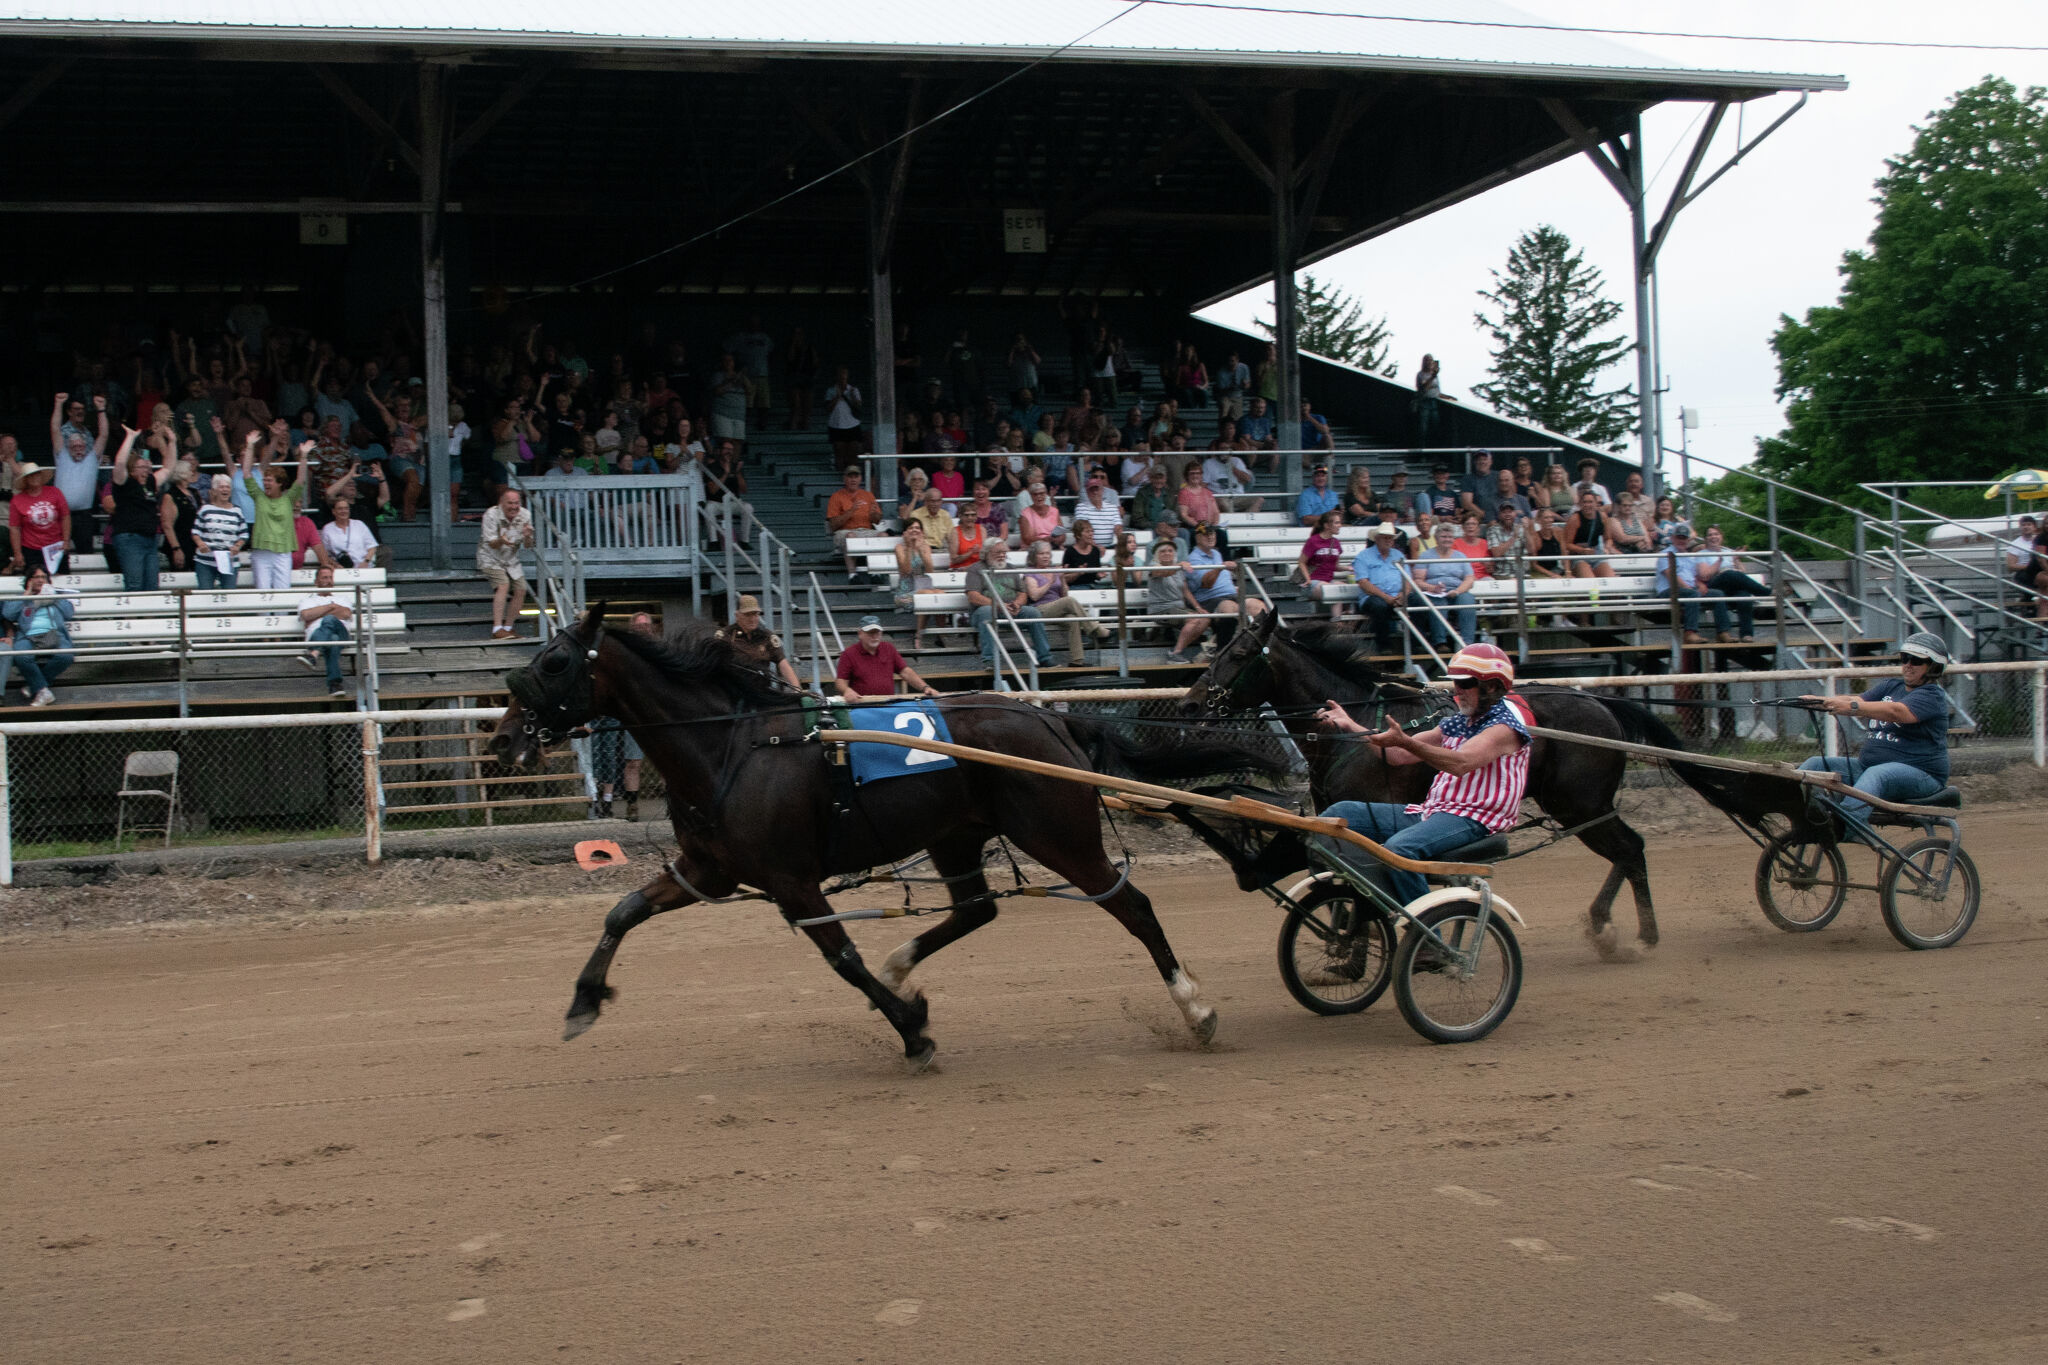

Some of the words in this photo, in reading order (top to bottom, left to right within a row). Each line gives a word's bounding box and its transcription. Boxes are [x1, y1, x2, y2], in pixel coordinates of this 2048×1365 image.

[1006, 216, 1044, 229] SECT
[1022, 237, 1032, 250] E
[66, 576, 81, 585] 23
[161, 574, 176, 582] 25
[950, 573, 956, 582] 2
[116, 597, 131, 605] 24
[67, 623, 81, 631] 23
[116, 622, 131, 630] 24
[216, 618, 232, 628] 26
[264, 617, 280, 626] 27
[894, 711, 950, 766] 2
